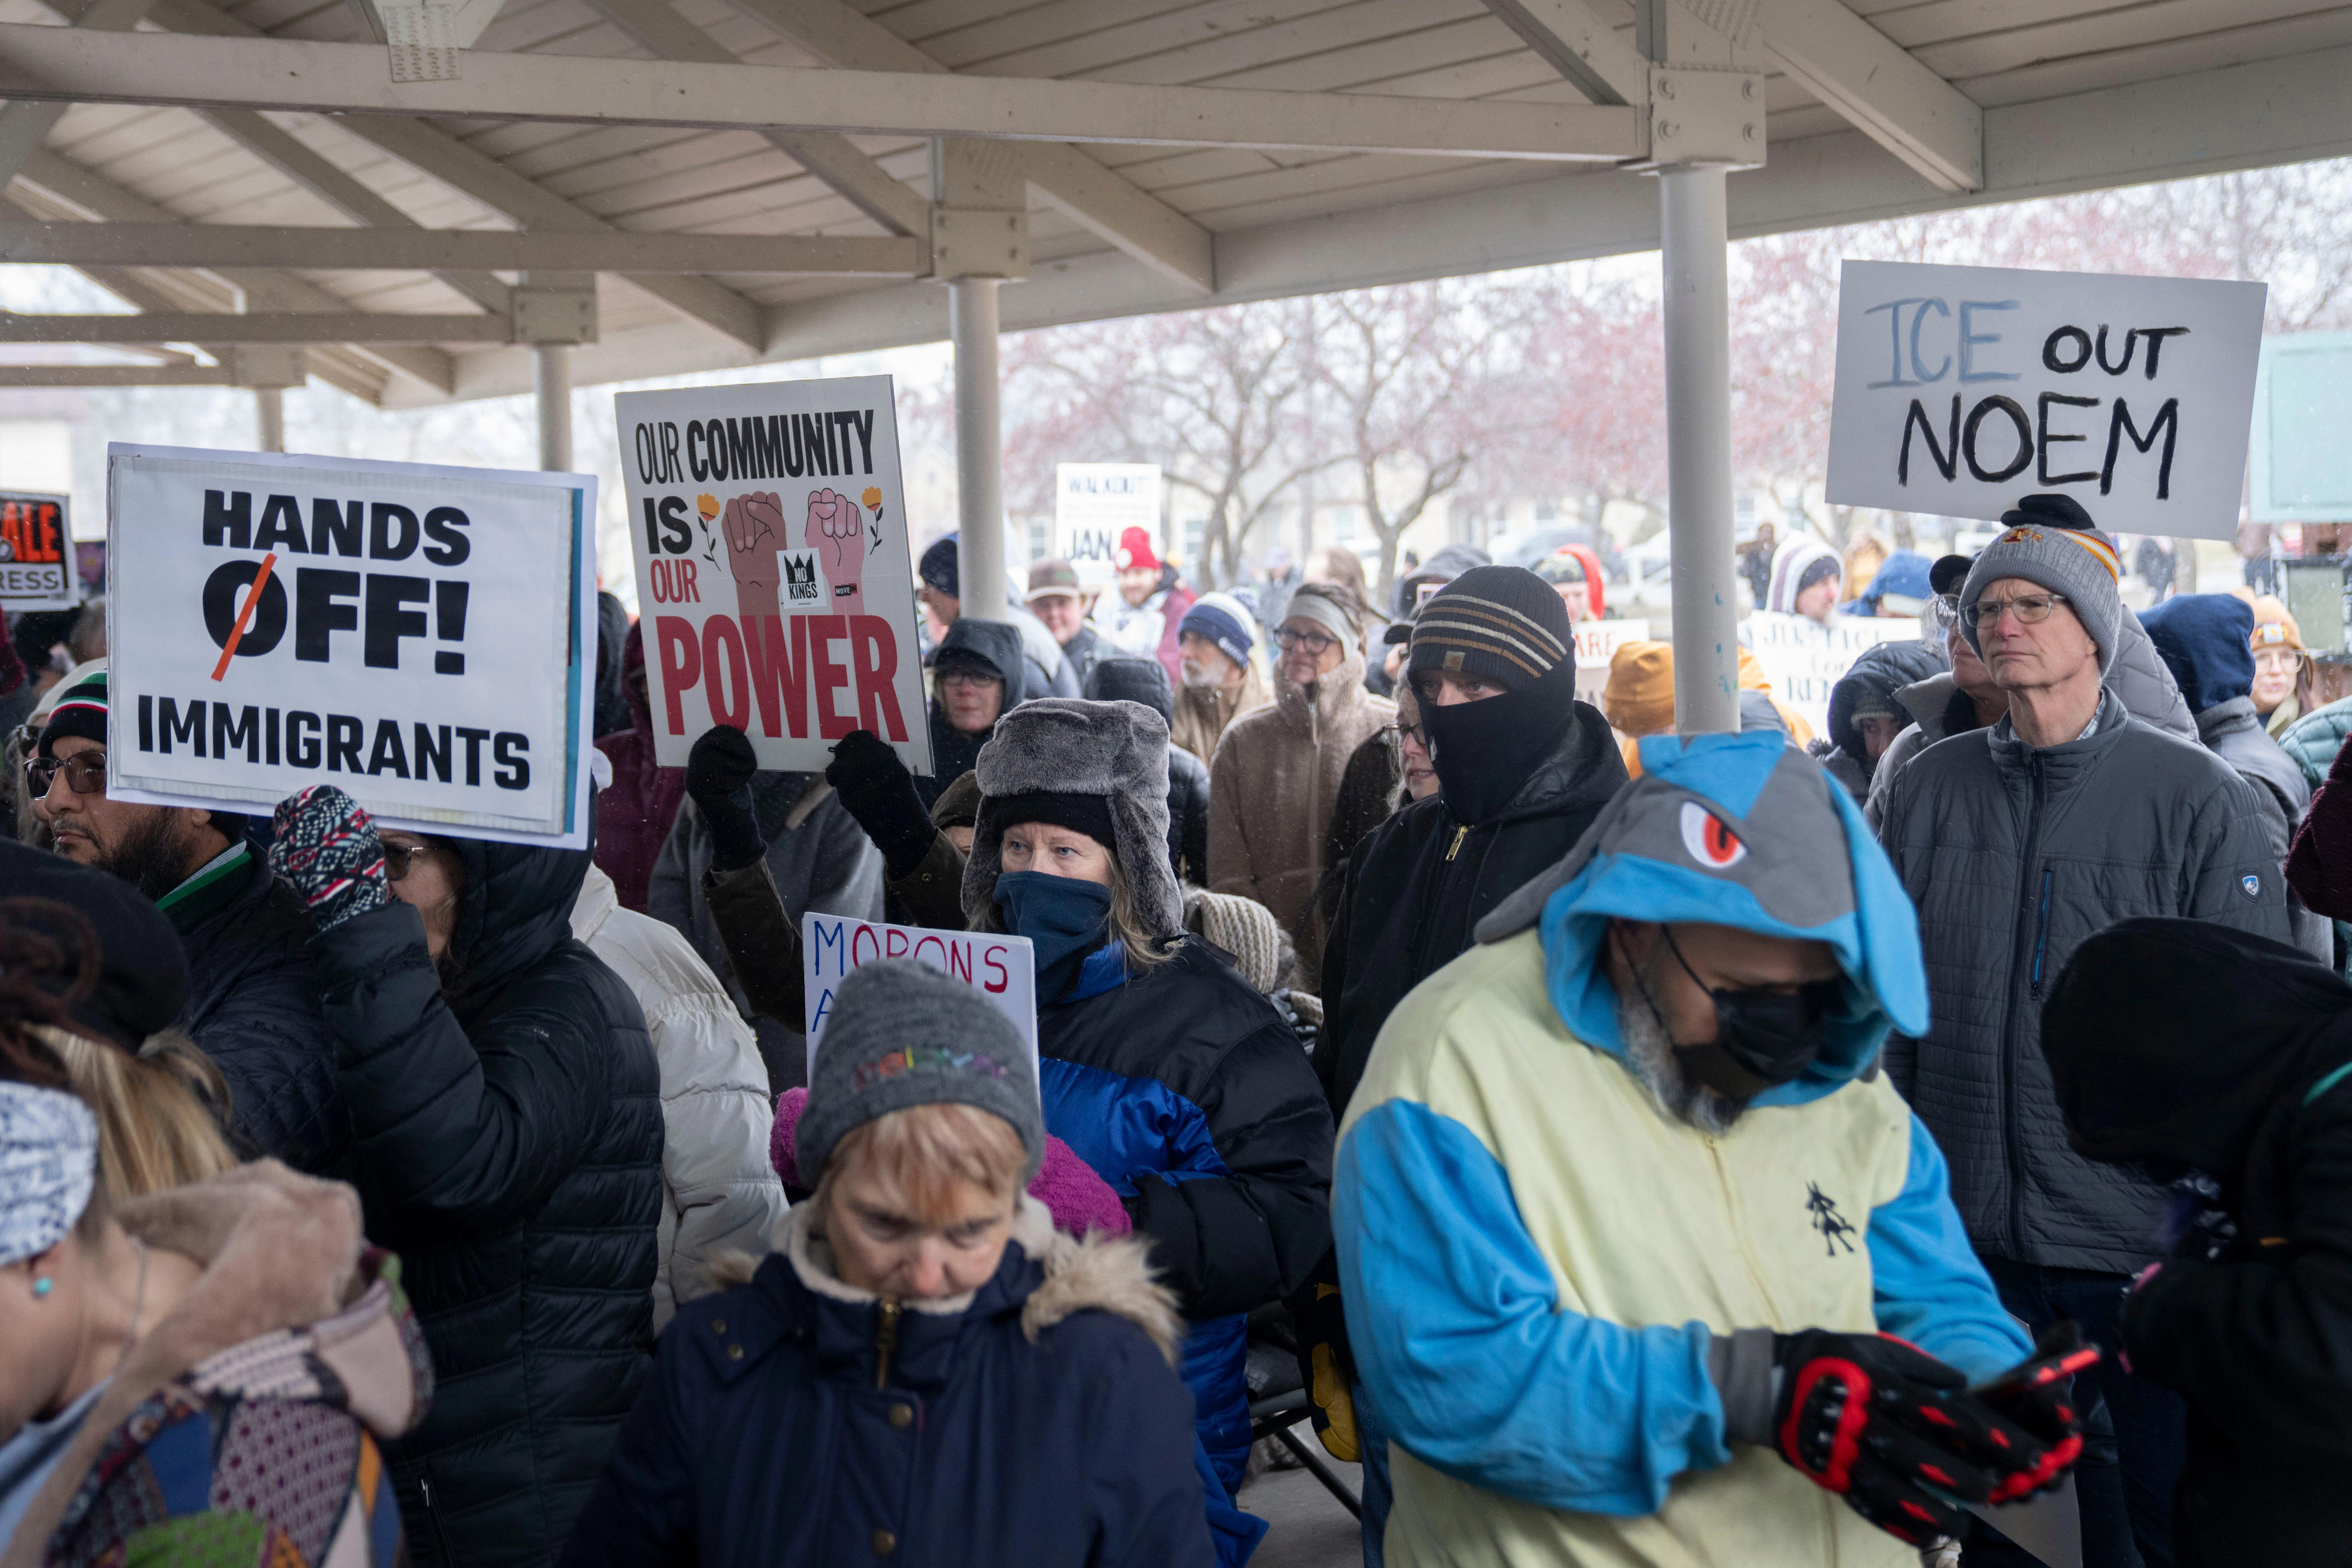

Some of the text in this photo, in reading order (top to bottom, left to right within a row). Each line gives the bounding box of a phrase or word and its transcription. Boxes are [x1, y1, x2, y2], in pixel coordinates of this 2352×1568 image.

[1864, 297, 2191, 389] ICE OUT
[636, 409, 875, 485] OUR COMMUNITY
[1898, 391, 2179, 500] NOEM
[202, 489, 471, 566] HANDS
[643, 495, 693, 555] IS
[650, 558, 701, 604] OUR
[789, 583, 818, 600] KINGS
[794, 567, 808, 582] NO
[202, 560, 470, 675] OFF!
[655, 613, 910, 743] POWER
[138, 695, 530, 791] IMMIGRANTS
